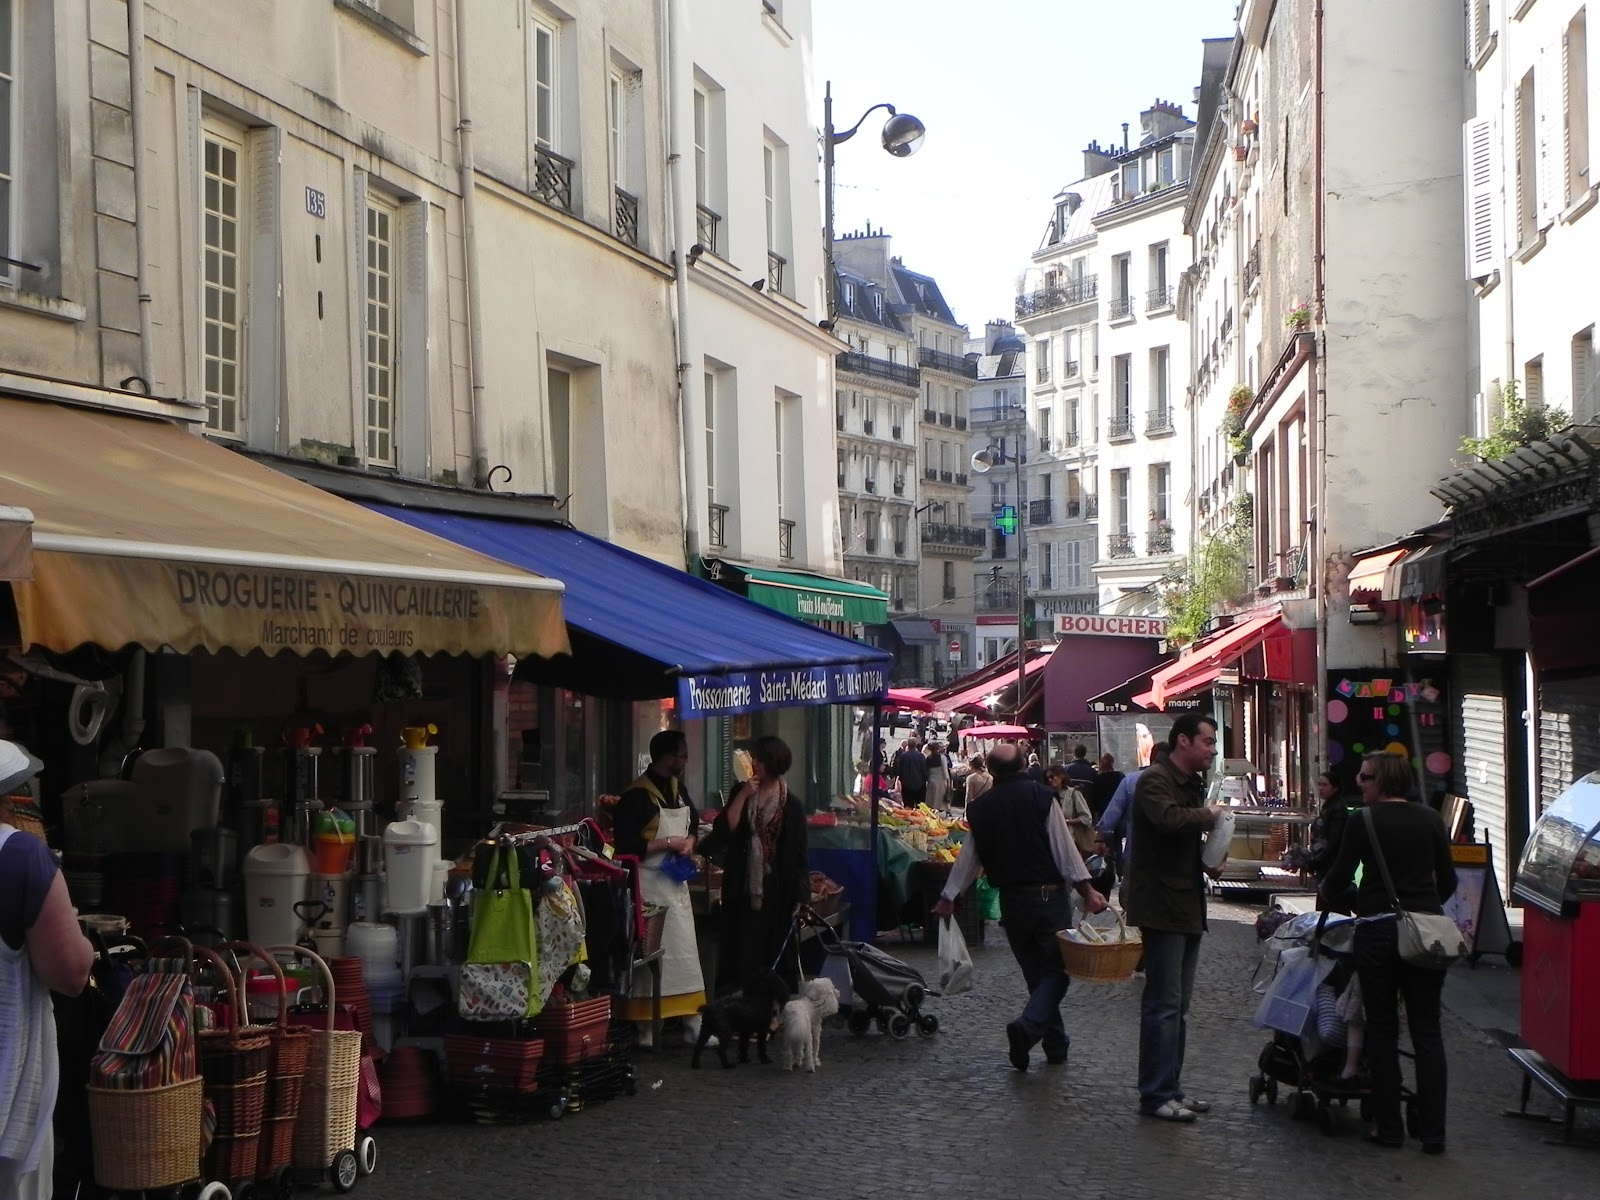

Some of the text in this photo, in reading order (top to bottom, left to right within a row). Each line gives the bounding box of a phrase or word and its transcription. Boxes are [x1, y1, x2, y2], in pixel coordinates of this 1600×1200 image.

[306, 188, 324, 217] 135
[177, 569, 317, 611] DROGUERIE
[338, 580, 478, 618] QUINCAILLERIE
[1043, 599, 1099, 618] PHARMACIE
[262, 620, 413, 647] Marchand de couleurs
[688, 674, 751, 710] Poissonnerie
[760, 669, 827, 703] Saint-Médard
[1168, 699, 1201, 709] manger
